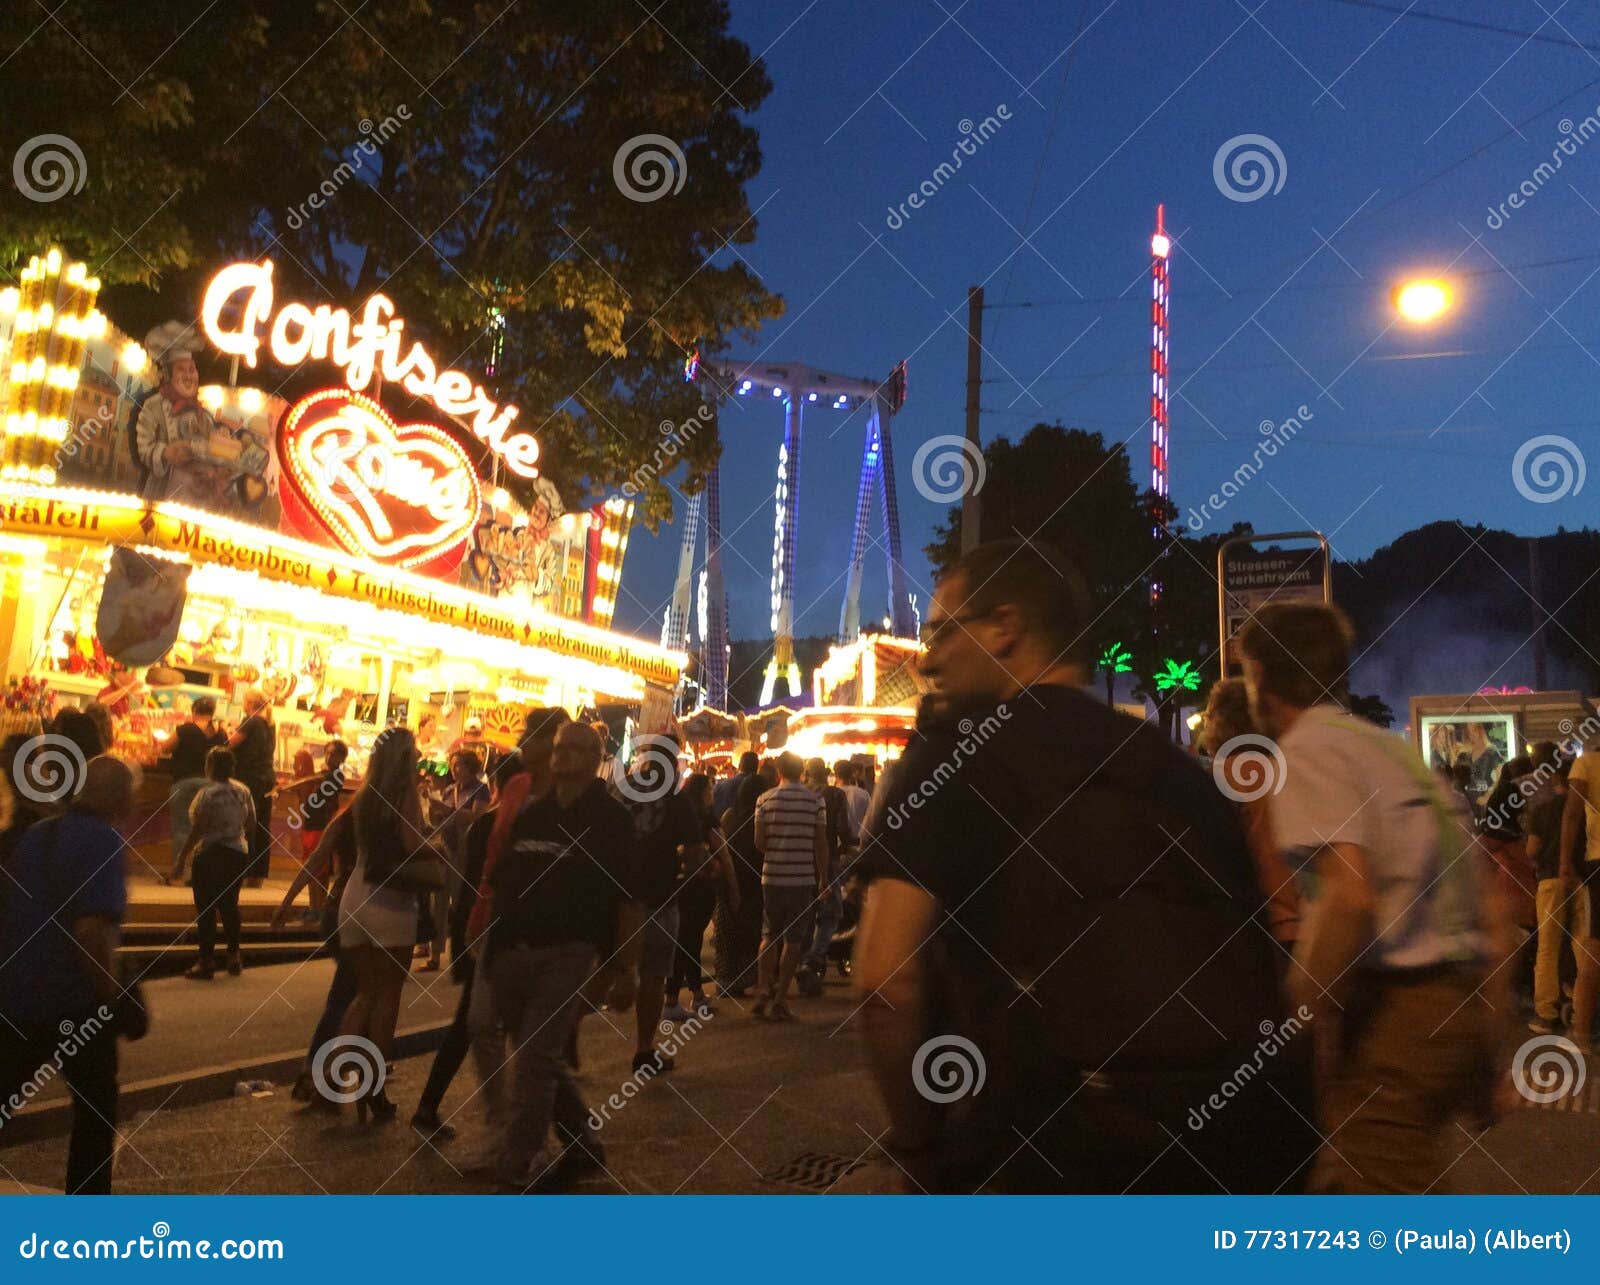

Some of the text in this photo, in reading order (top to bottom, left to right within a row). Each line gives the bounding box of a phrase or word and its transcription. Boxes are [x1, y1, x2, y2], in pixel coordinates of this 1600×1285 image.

[202, 257, 541, 479] Confiserie
[172, 520, 313, 581] Magenbrot
[538, 627, 612, 661] gebrannte
[616, 646, 673, 678] Mandeln
